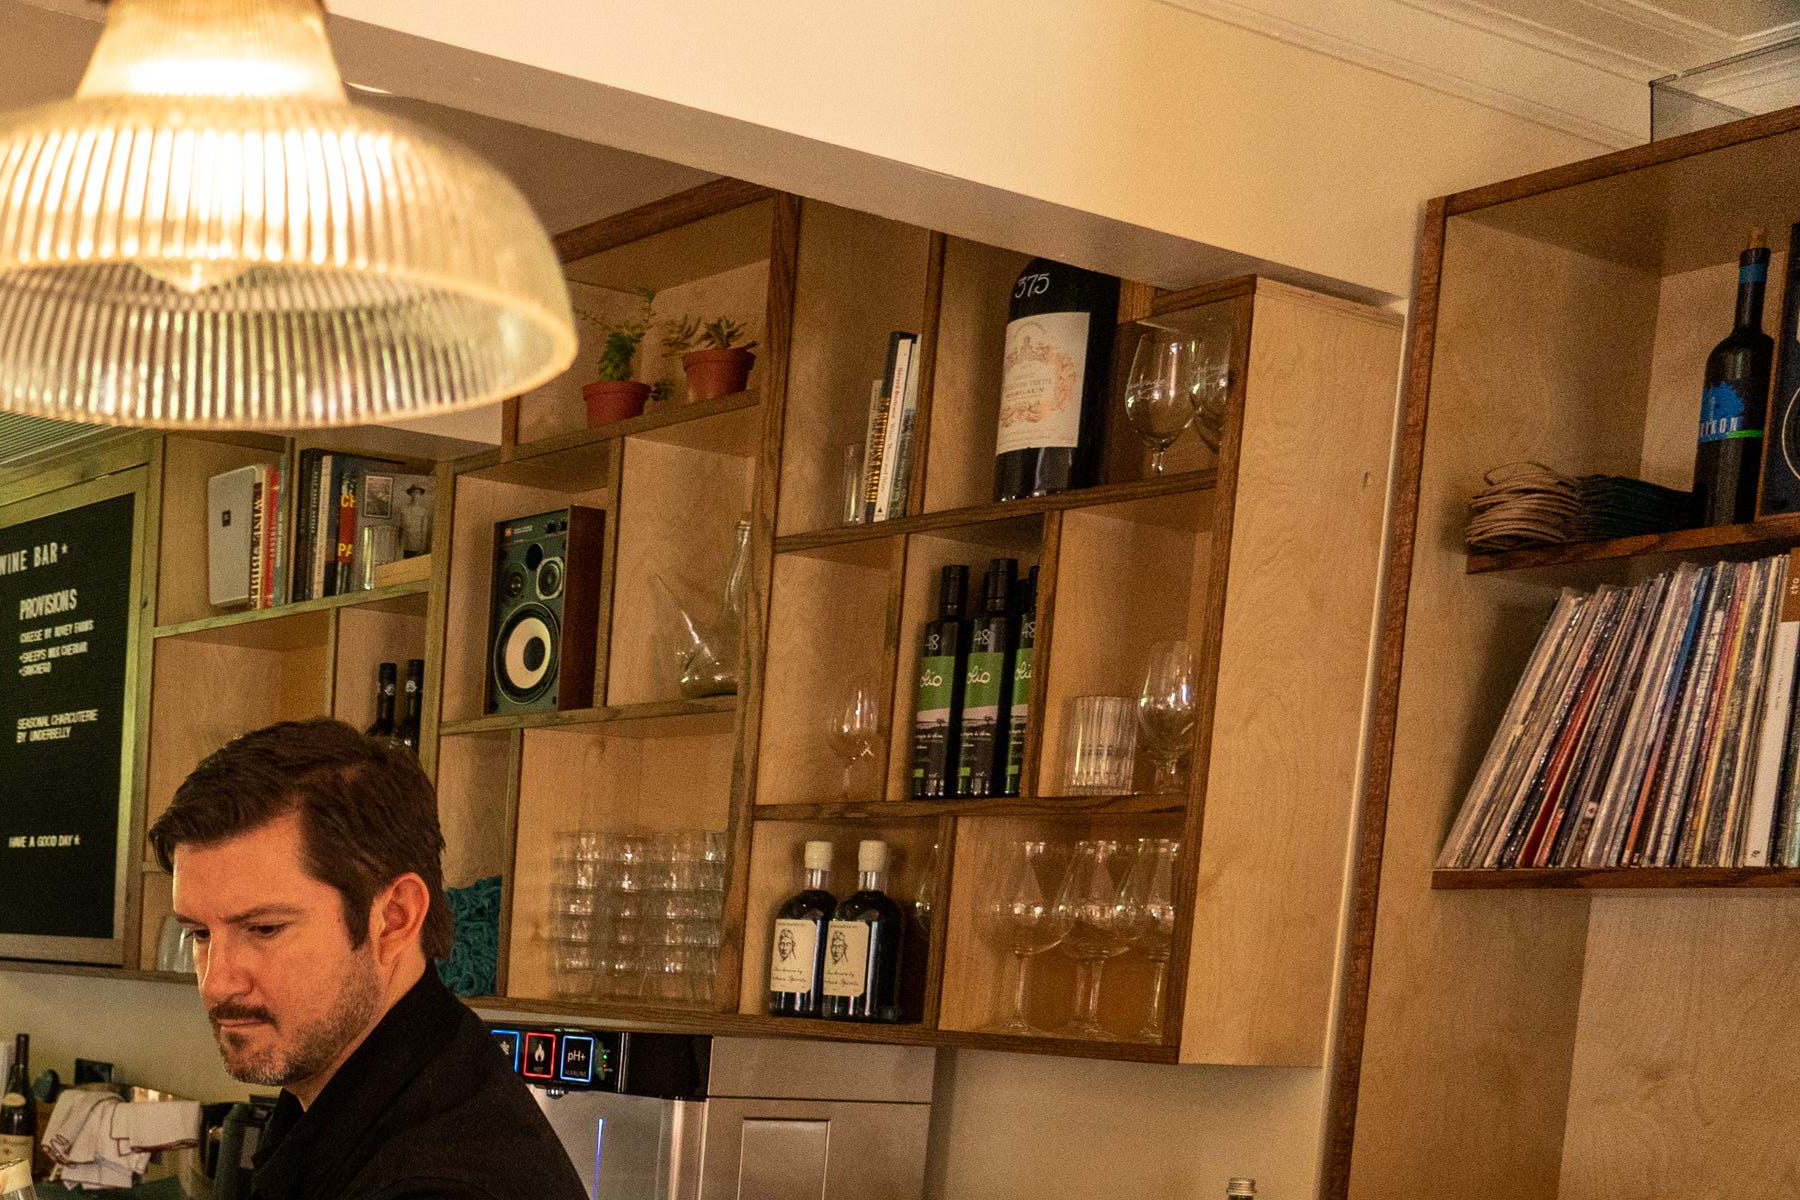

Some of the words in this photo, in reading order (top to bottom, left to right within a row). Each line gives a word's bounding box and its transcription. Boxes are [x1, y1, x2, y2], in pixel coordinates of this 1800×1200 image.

[1014, 272, 1050, 300] 375
[33, 542, 59, 568] BAR
[19, 588, 78, 620] PROVISIONS
